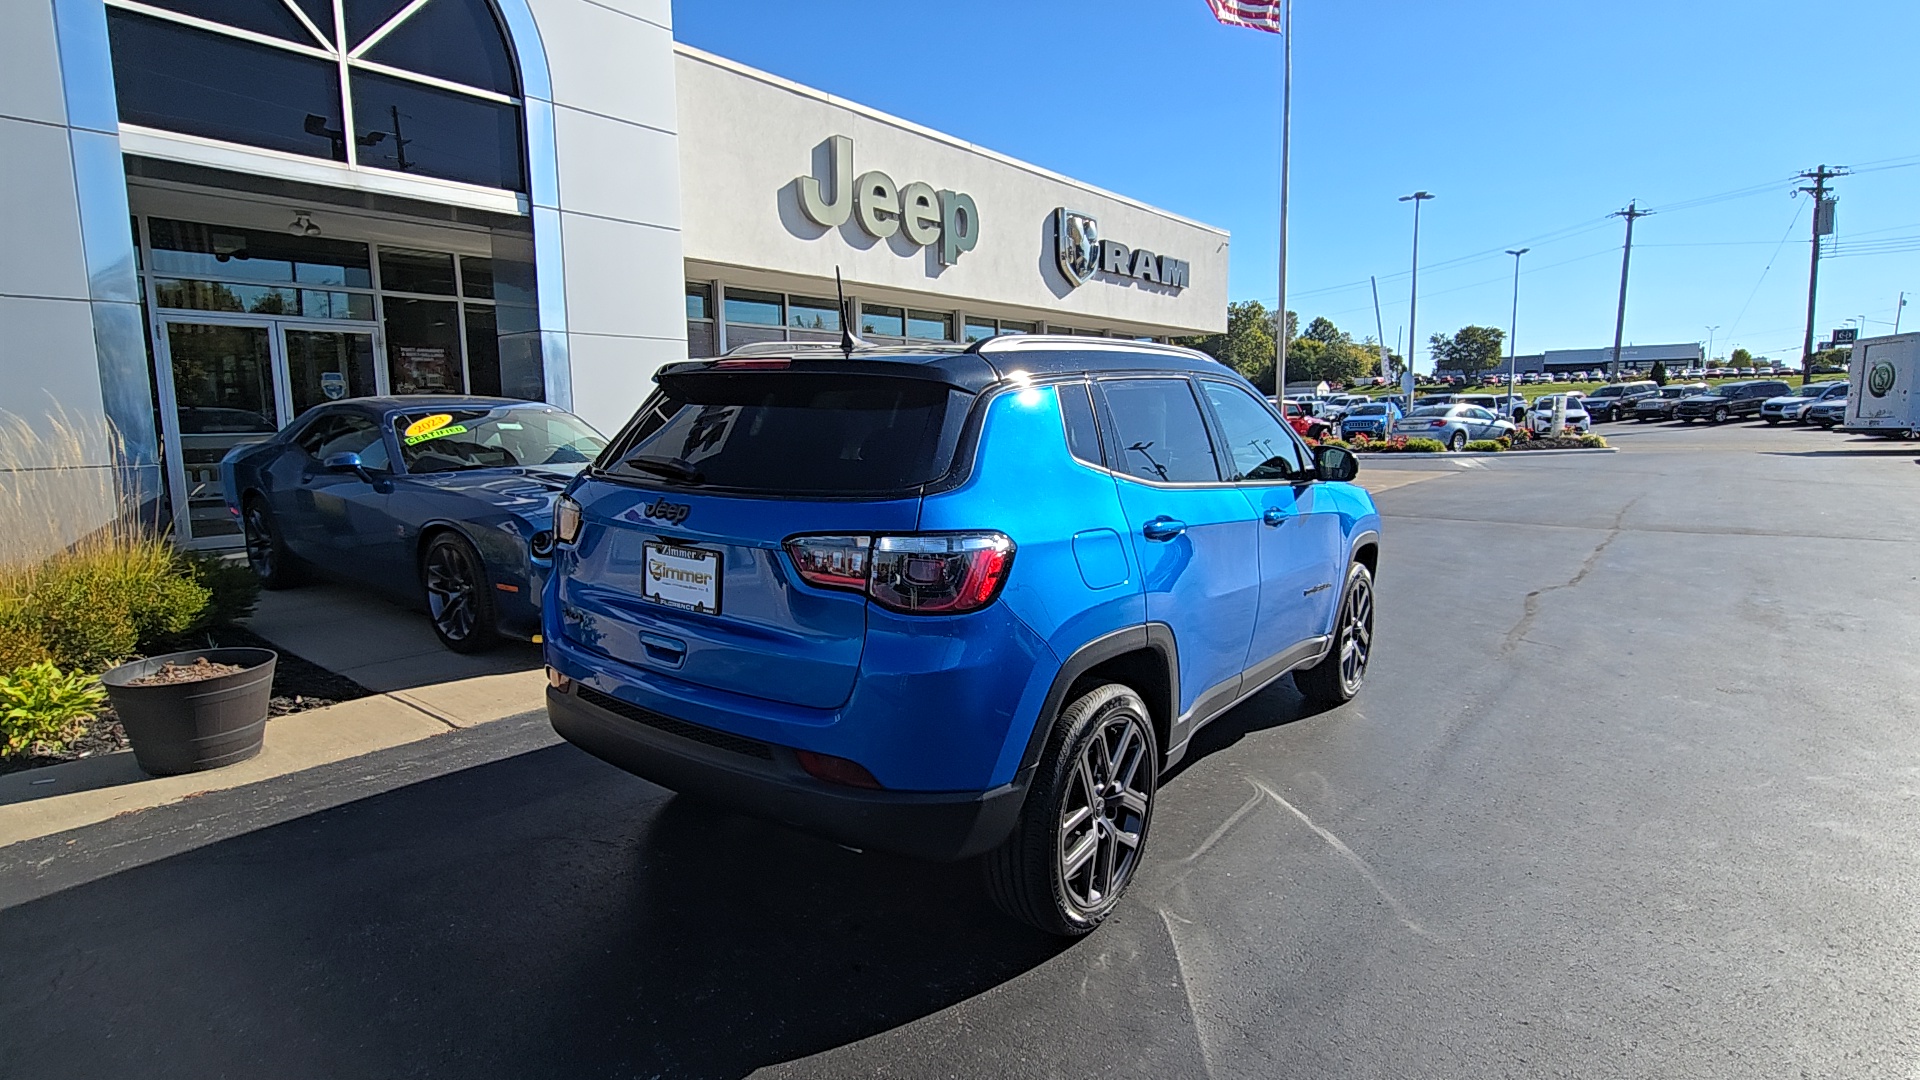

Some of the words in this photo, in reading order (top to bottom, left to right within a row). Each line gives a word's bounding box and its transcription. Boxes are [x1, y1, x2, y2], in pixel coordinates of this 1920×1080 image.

[799, 135, 979, 266] Jeep
[1103, 239, 1191, 288] RAM
[407, 426, 464, 444] CERTIFIED
[414, 416, 445, 434] 2023
[646, 498, 689, 525] Jeep
[661, 544, 697, 559] Zimmer
[650, 560, 712, 585] Zimmer
